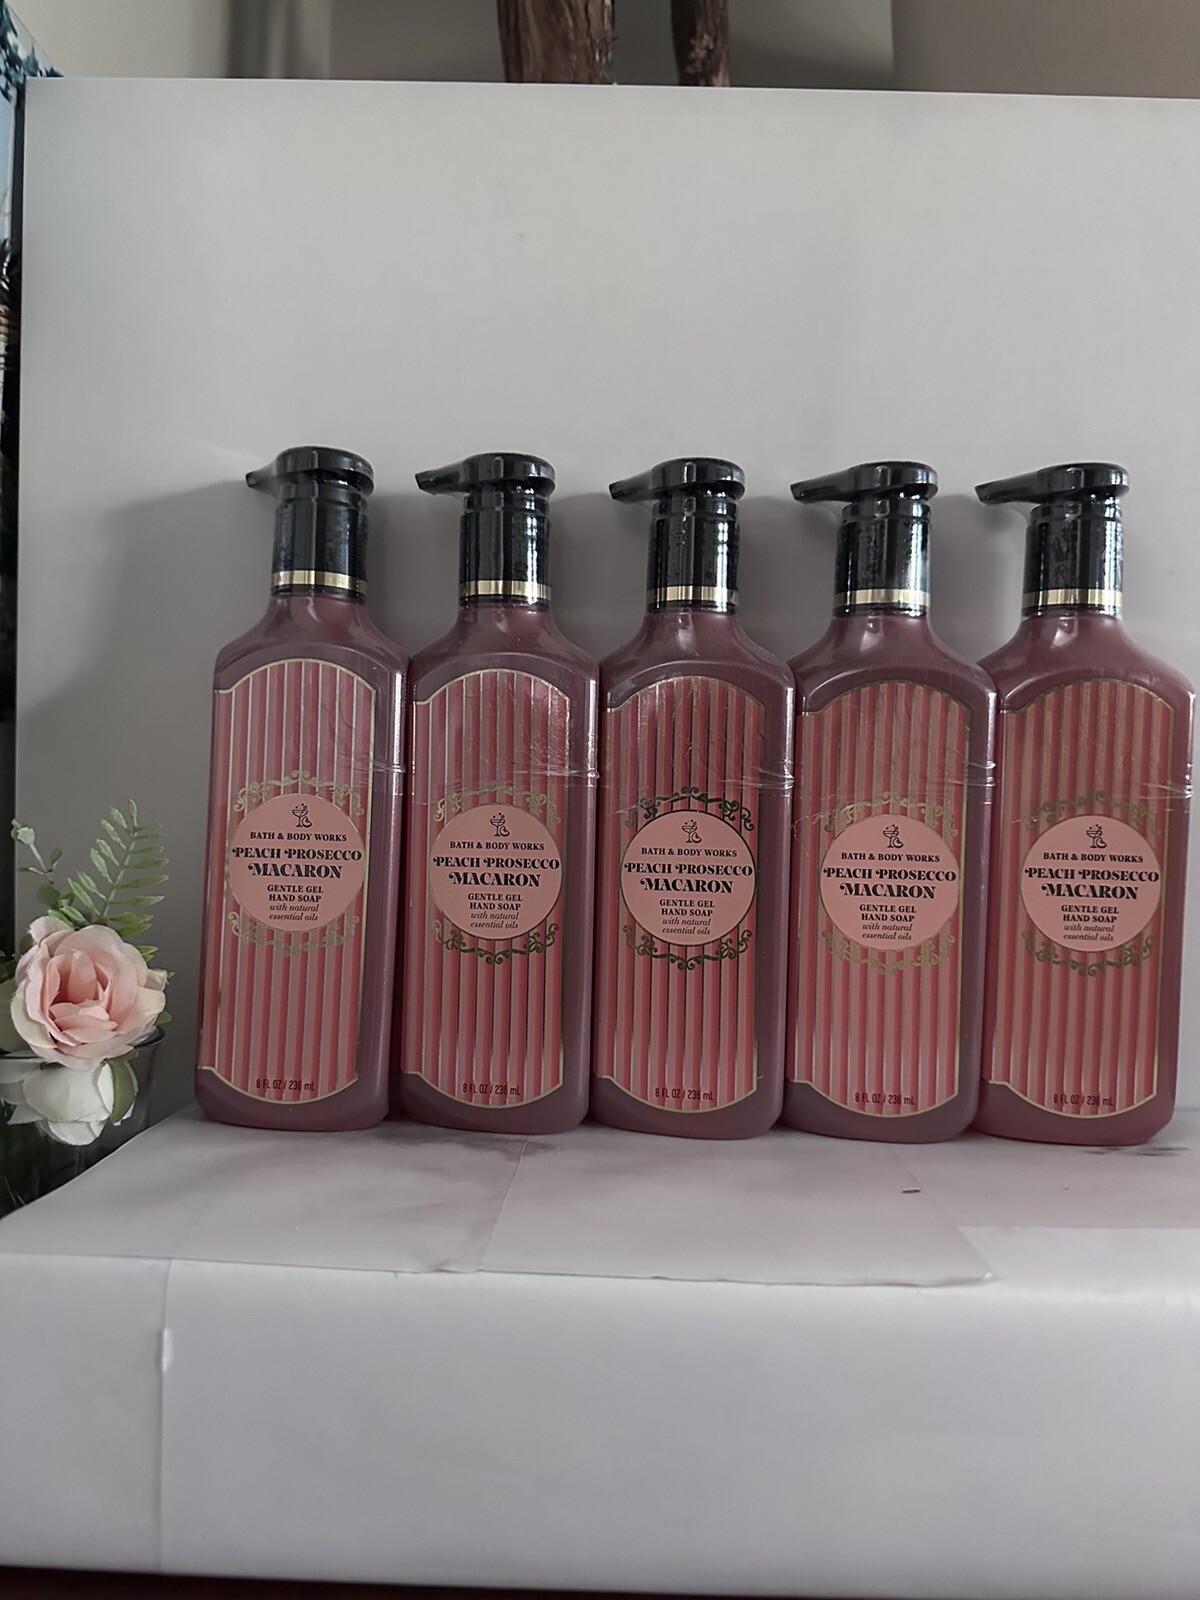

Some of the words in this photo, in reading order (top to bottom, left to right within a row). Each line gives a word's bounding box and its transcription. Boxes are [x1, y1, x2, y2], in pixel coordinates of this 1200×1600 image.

[232, 847, 280, 858] PEACH
[285, 849, 362, 861] PROSECCO
[678, 848, 702, 856] BODY
[704, 849, 737, 857] WORKS
[906, 854, 940, 862] WORKS
[433, 857, 480, 867] PEACH
[483, 858, 560, 869] PROSECCO
[248, 863, 342, 878] MACARON
[624, 863, 672, 873] PEACH
[675, 864, 753, 876] PROSECCO
[823, 868, 872, 878] PEACH
[876, 869, 956, 881] PROSECCO
[1025, 868, 1075, 879] PEACH
[1078, 869, 1159, 882] PROSECCO
[449, 872, 541, 887] MACARON
[640, 878, 733, 893] MACARON
[840, 883, 936, 898] MACARON
[1042, 883, 1138, 899] MACARON
[468, 893, 503, 901] GENTLE
[270, 903, 287, 911] with
[289, 904, 319, 912] natural
[660, 899, 694, 907] GENTLE
[697, 900, 715, 908] GEL
[860, 904, 896, 912] GENTLE
[1061, 905, 1098, 913] GENTLE
[1101, 906, 1119, 914] GEL
[269, 912, 303, 920] essential
[305, 913, 318, 921] oils
[490, 912, 519, 920] natural
[1063, 914, 1089, 922] HAND
[1093, 915, 1117, 923] SOAP
[505, 921, 518, 929] oils
[662, 917, 679, 925] with
[681, 918, 711, 926] natural
[662, 926, 695, 934] essential
[697, 927, 710, 935] oils
[863, 922, 879, 930] with
[882, 923, 912, 931] natural
[1064, 923, 1081, 931] with
[1084, 924, 1114, 932] natural
[862, 932, 896, 940] essential
[898, 932, 911, 940] oils
[1100, 933, 1114, 941] oils
[263, 1079, 270, 1089] FL
[273, 1080, 282, 1089] OZ
[289, 1080, 301, 1090] 236
[470, 1084, 477, 1093] FL
[479, 1084, 488, 1094] OZ
[495, 1085, 507, 1094] 236
[662, 1088, 669, 1098] FL
[672, 1089, 680, 1098] OZ
[688, 1089, 701, 1100] 236
